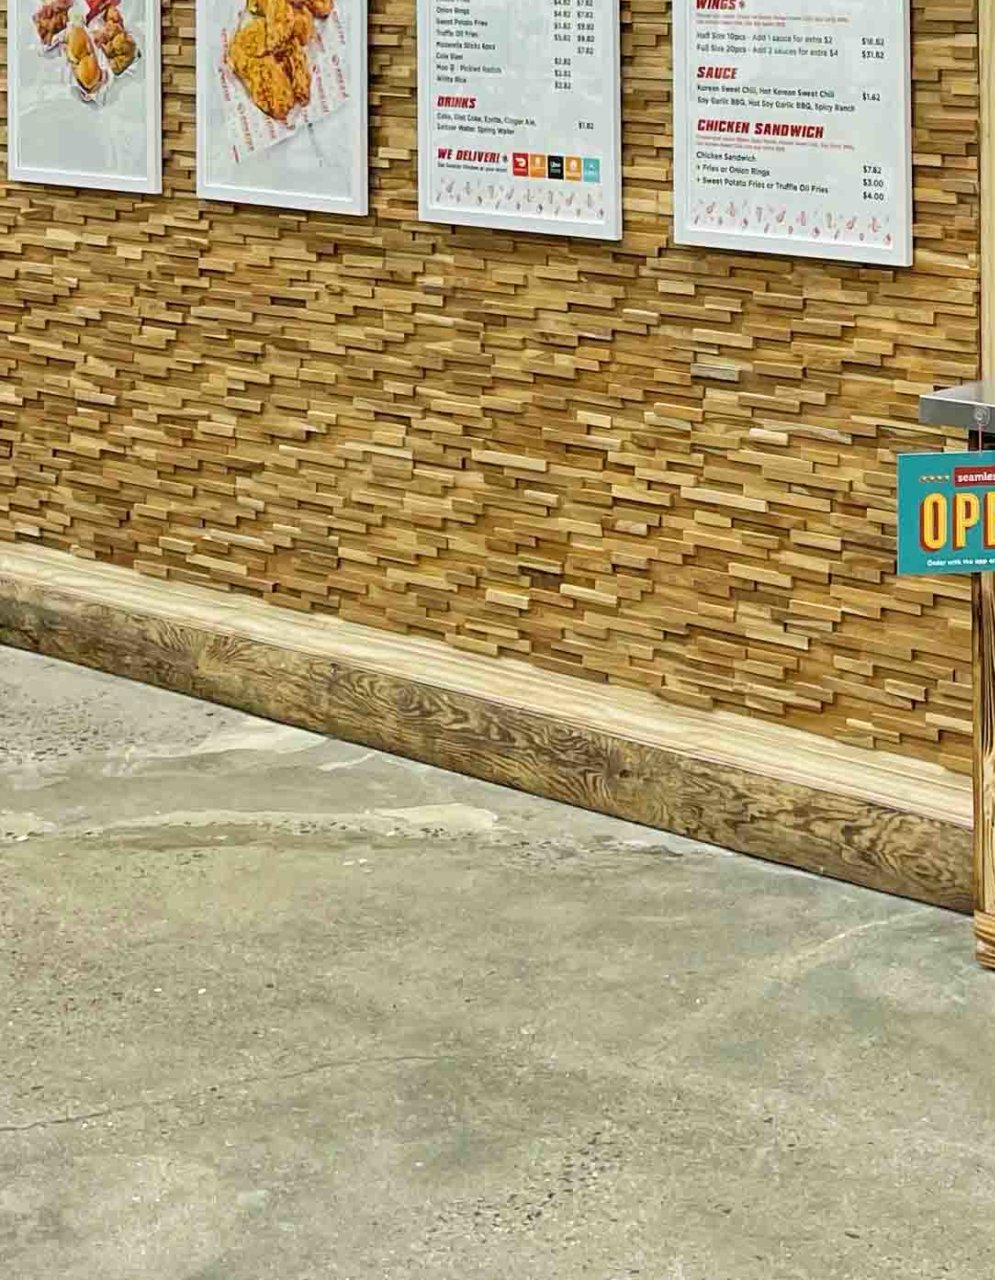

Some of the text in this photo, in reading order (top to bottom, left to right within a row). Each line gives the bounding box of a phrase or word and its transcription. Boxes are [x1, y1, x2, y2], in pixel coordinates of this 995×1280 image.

[697, 66, 738, 79] SAUCE
[437, 95, 477, 109] DRINKS
[697, 119, 824, 139] CHICKEN SANDWICH
[438, 148, 500, 163] WE DELIVER!
[696, 151, 756, 162] Chicken Sandwich
[702, 177, 723, 185] Sweet
[748, 180, 765, 189] Fries
[862, 178, 884, 188] $3.00
[863, 191, 884, 201] $4.00
